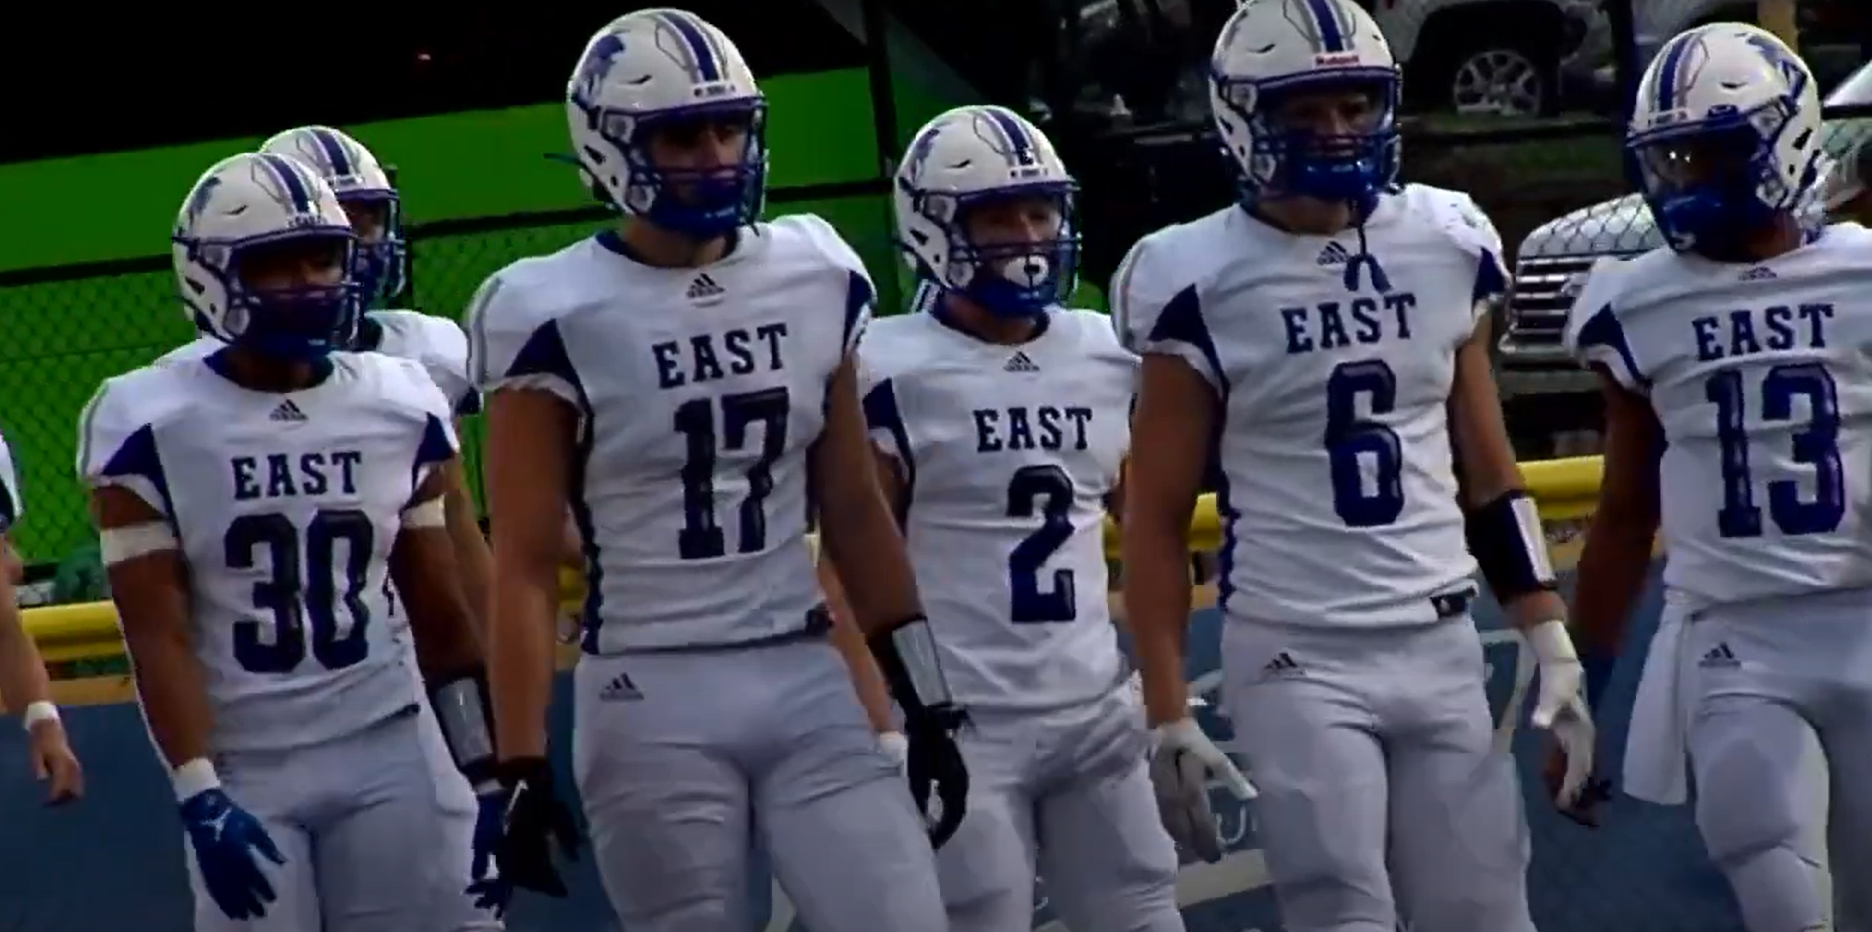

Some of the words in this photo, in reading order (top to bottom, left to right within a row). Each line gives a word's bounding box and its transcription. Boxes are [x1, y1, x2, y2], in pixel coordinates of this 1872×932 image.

[652, 322, 787, 389] EAST
[1281, 293, 1416, 354] EAST
[1692, 303, 1834, 361] EAST
[231, 451, 361, 500] EAST
[674, 387, 789, 559] 17
[973, 406, 1093, 453] EAST
[1325, 359, 1404, 527] 6
[1705, 363, 1845, 538] 13
[224, 510, 373, 673] 30
[1006, 464, 1076, 624] 2
